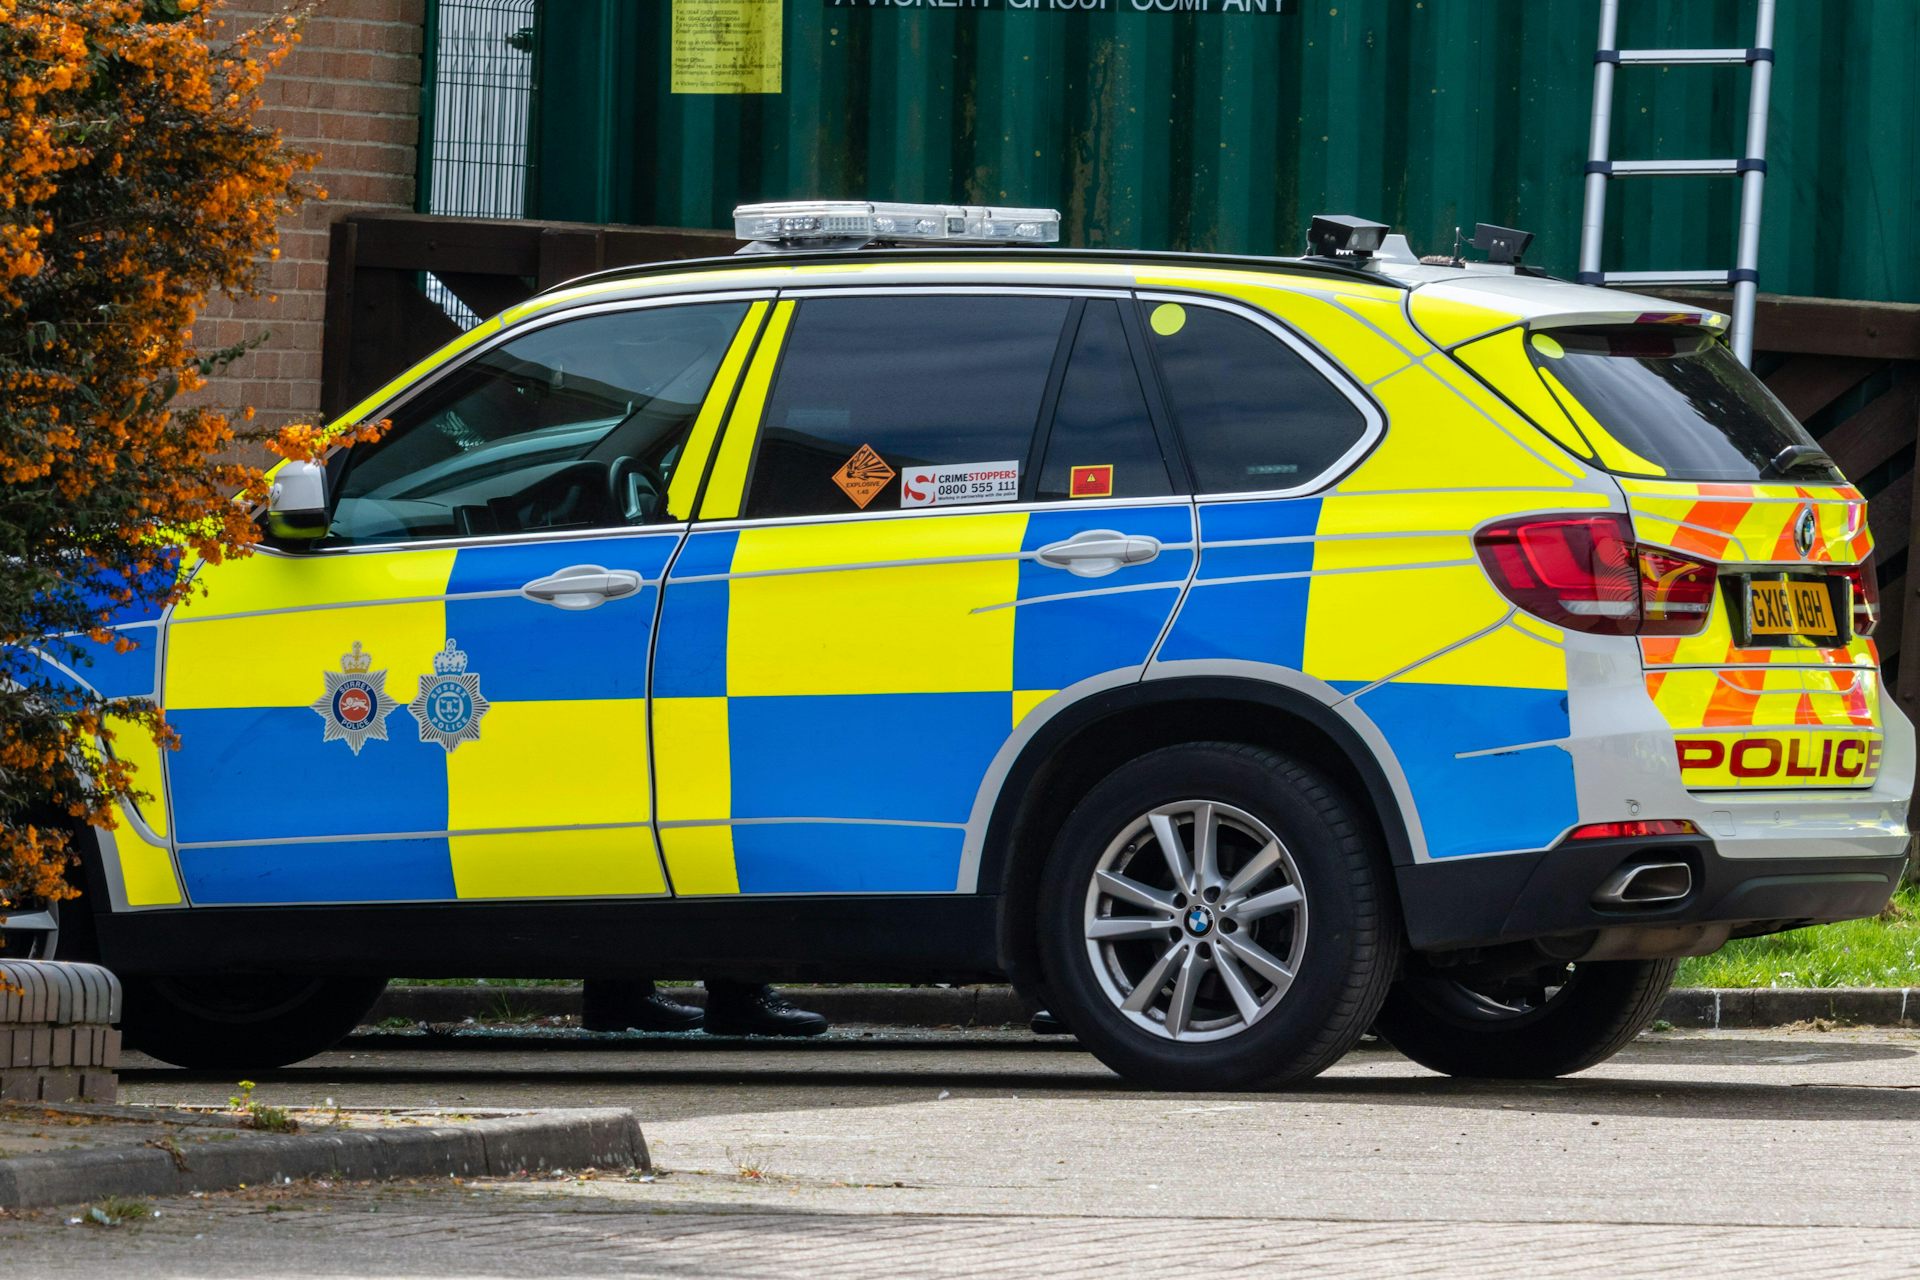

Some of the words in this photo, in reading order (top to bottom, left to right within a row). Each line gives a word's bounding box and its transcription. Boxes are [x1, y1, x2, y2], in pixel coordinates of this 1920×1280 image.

[938, 470, 1017, 483] CRIMESTOPPERS
[938, 484, 967, 495] 0800
[971, 482, 993, 493] 555
[998, 481, 1016, 491] 111
[339, 680, 371, 694] SURREY
[430, 683, 468, 699] SUSSEX
[341, 718, 370, 730] POLICE
[431, 717, 468, 731] POLICE
[1675, 738, 1883, 778] POLICE
